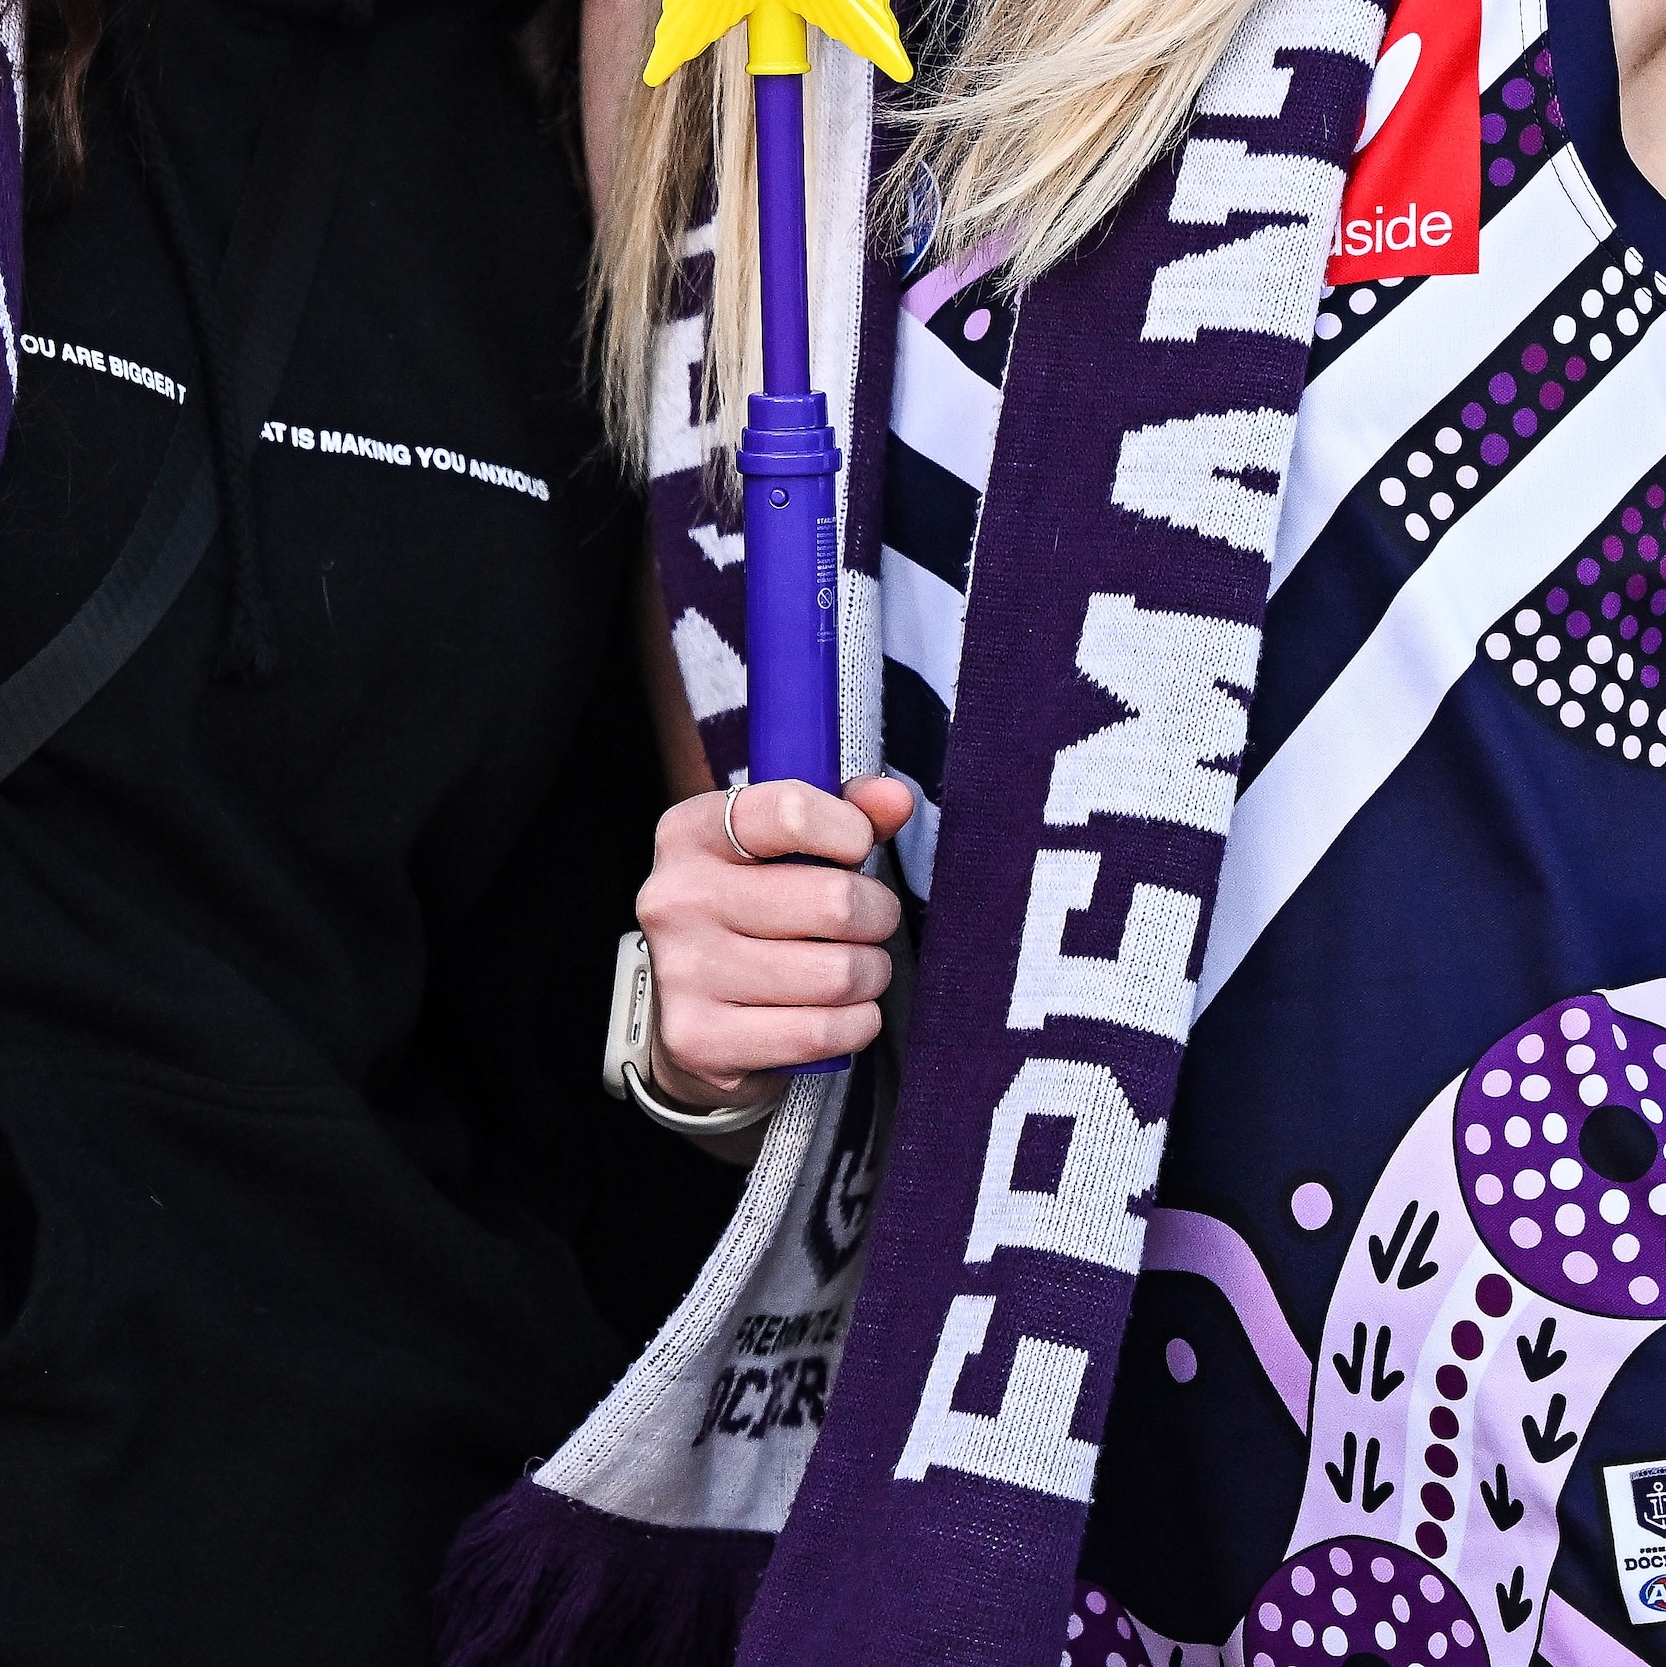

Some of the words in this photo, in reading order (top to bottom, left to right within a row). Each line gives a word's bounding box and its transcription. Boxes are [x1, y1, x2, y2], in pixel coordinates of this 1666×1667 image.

[19, 334, 55, 358] OU
[62, 343, 107, 372] ARE
[109, 355, 175, 400] BIGGER
[177, 383, 187, 405] T
[260, 421, 287, 443] AT
[290, 426, 315, 450] IS
[320, 430, 411, 466] MAKING
[415, 446, 466, 474] YOU
[469, 459, 550, 502] ANXIOUS
